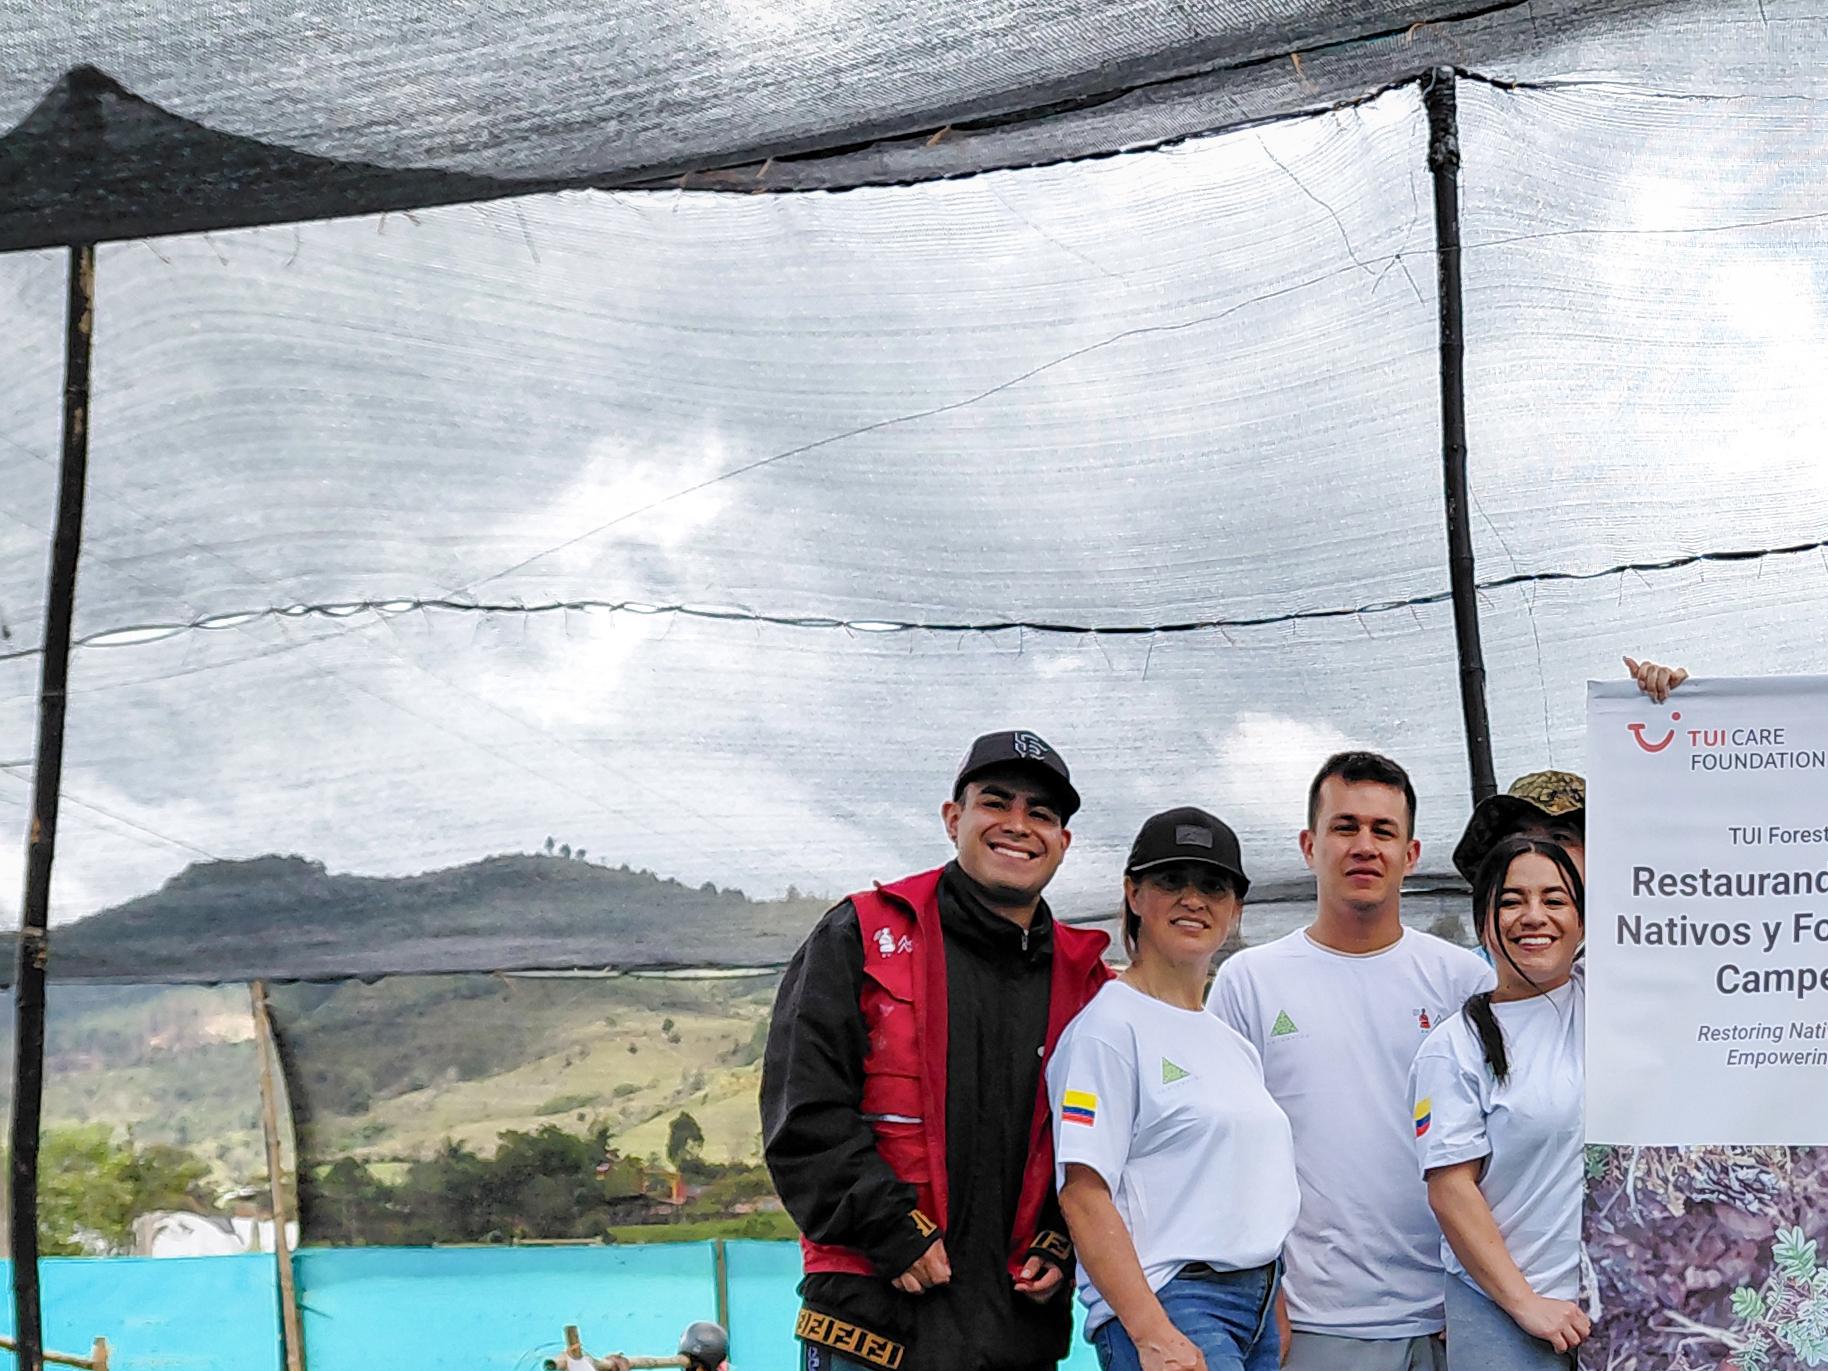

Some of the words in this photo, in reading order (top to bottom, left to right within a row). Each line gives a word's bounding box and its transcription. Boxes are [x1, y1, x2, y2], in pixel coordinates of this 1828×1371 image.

[1688, 730, 1726, 747] TUI
[1731, 728, 1785, 746] CARE
[1691, 750, 1826, 770] FOUNDATION
[1728, 827, 1762, 846] TUI
[1616, 914, 1751, 946] Nativos
[1762, 920, 1783, 953] y
[1697, 1023, 1784, 1043] Restoring
